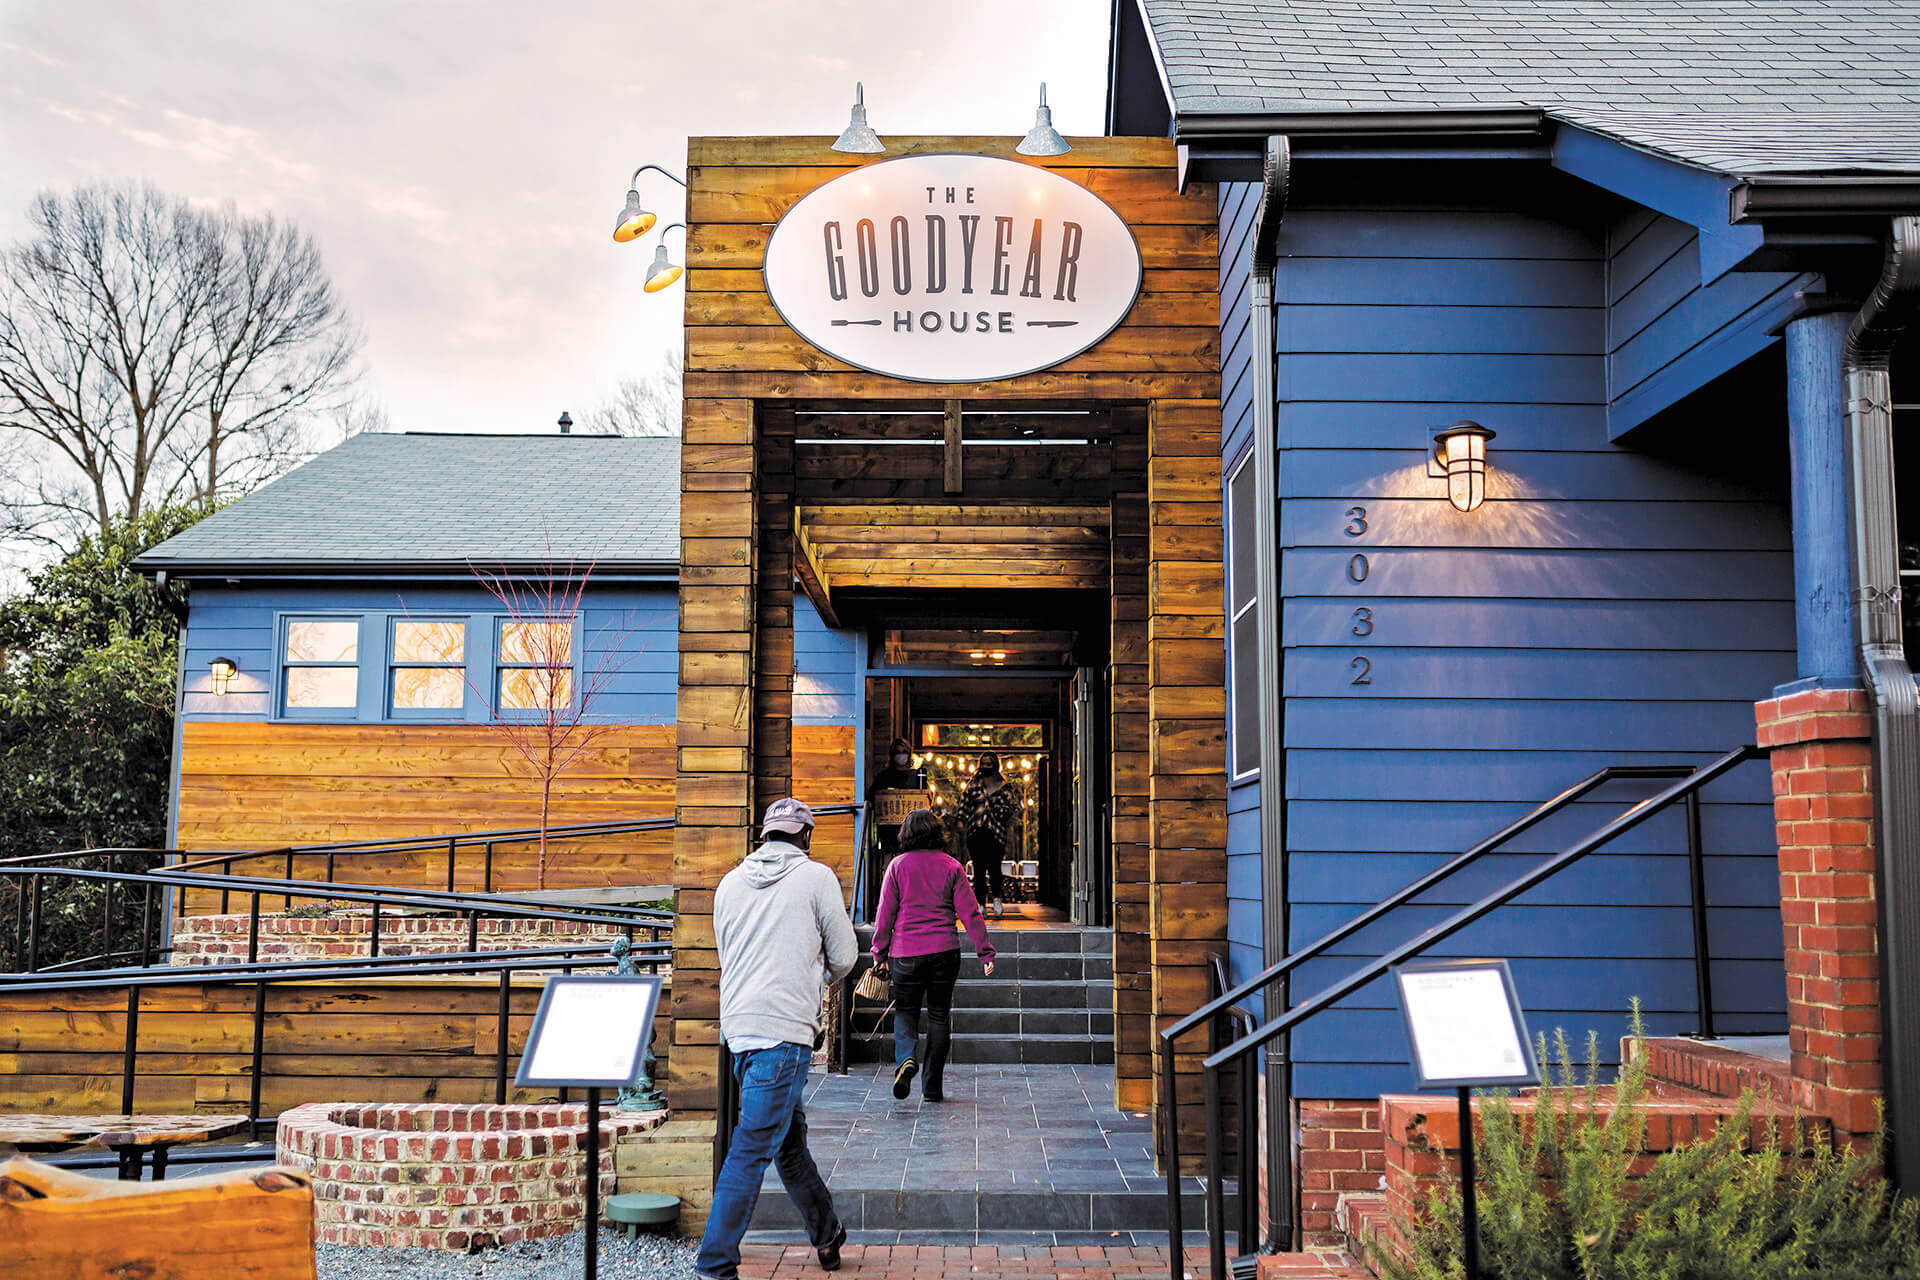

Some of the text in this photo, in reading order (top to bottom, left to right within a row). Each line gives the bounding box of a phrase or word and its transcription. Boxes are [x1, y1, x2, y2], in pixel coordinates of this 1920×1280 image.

[926, 187, 975, 204] THE
[823, 214, 1083, 303] GOODYEAR
[893, 310, 1014, 333] HOUSE
